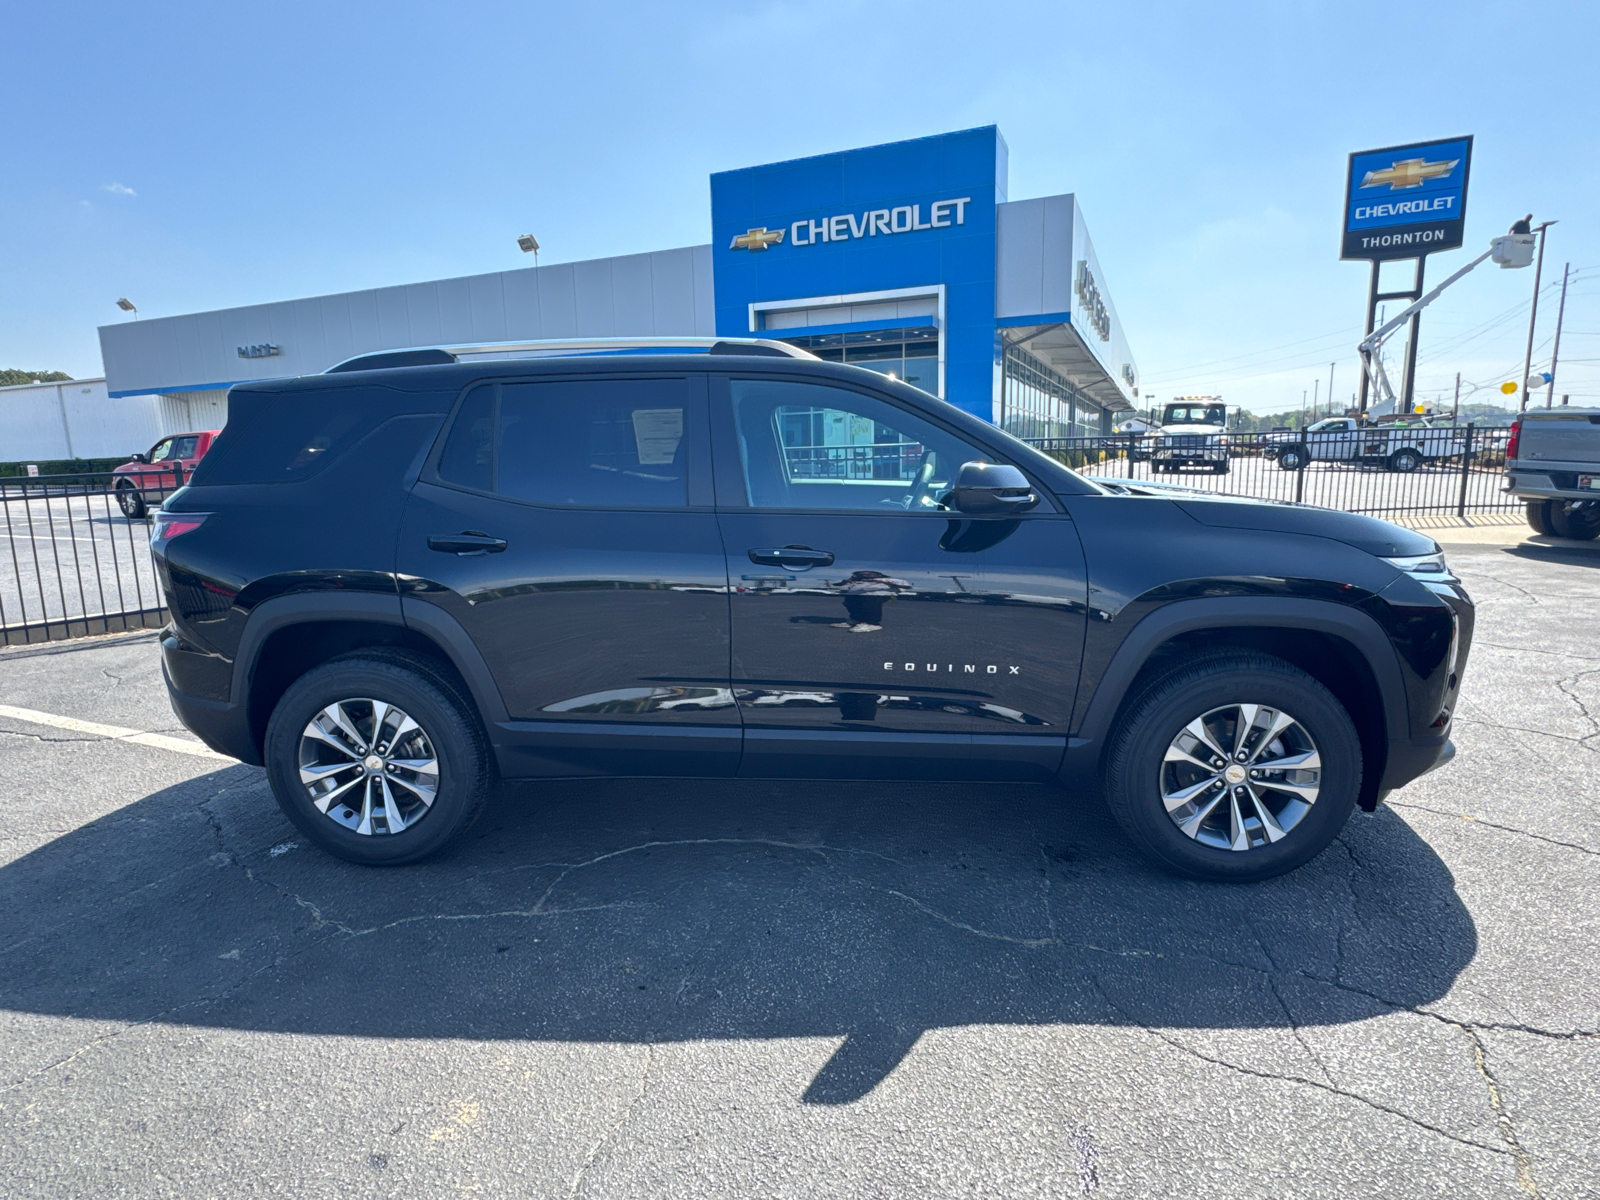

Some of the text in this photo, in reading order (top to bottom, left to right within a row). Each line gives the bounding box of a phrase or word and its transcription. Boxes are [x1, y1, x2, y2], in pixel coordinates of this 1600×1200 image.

[1355, 196, 1456, 219] CHEVROLET
[791, 197, 971, 246] CHEVROLET
[1362, 229, 1445, 248] THORNTON
[237, 343, 271, 358] PARTS
[883, 662, 1020, 675] EQUINOX
